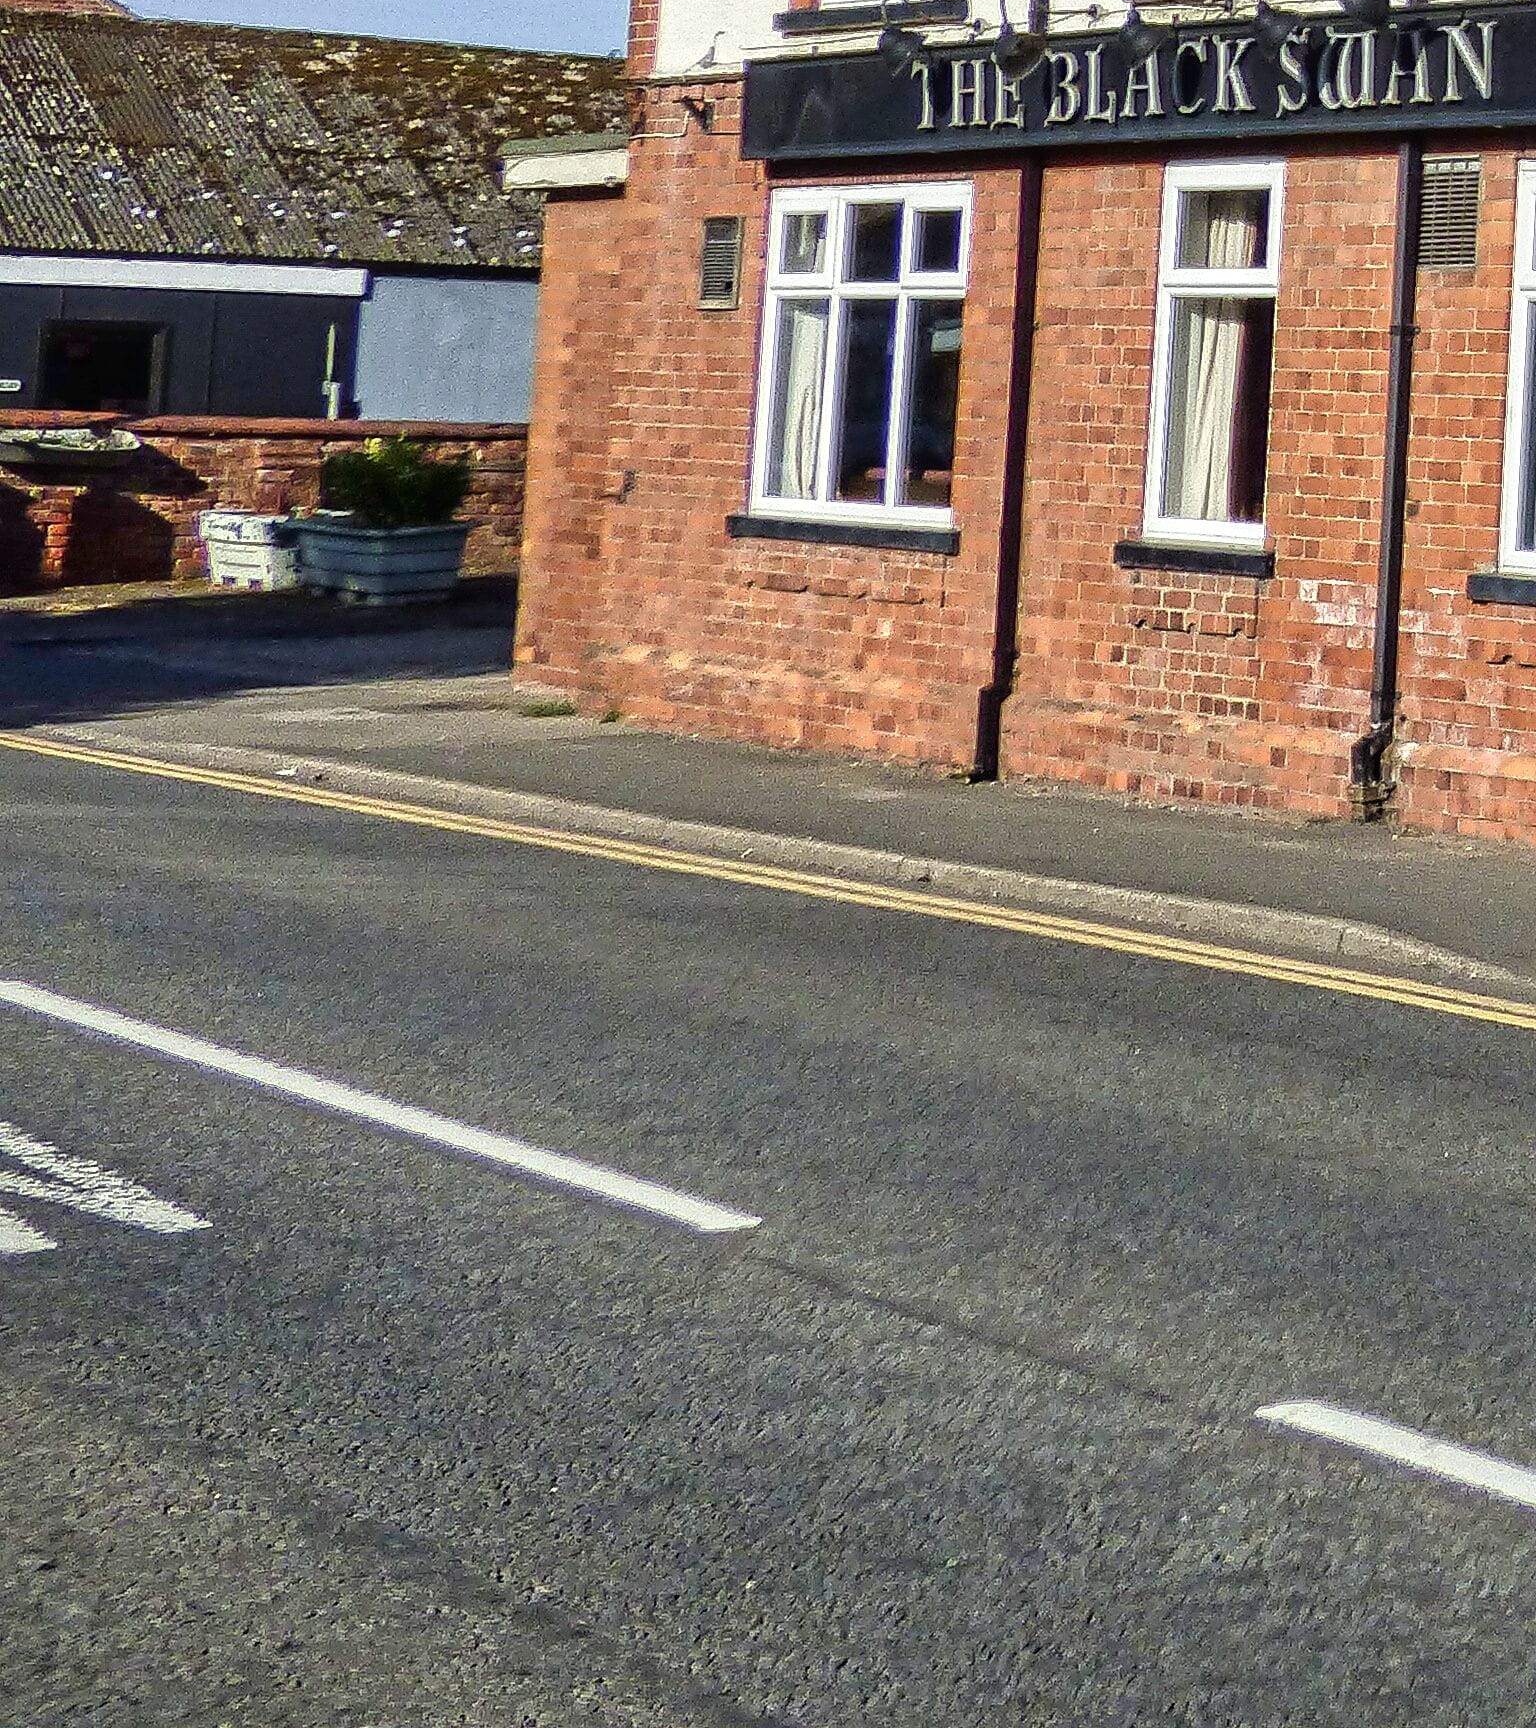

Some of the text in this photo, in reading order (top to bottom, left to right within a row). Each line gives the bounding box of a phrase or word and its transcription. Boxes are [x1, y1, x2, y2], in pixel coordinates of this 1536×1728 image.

[910, 19, 1499, 131] THE BLACK SWAN
